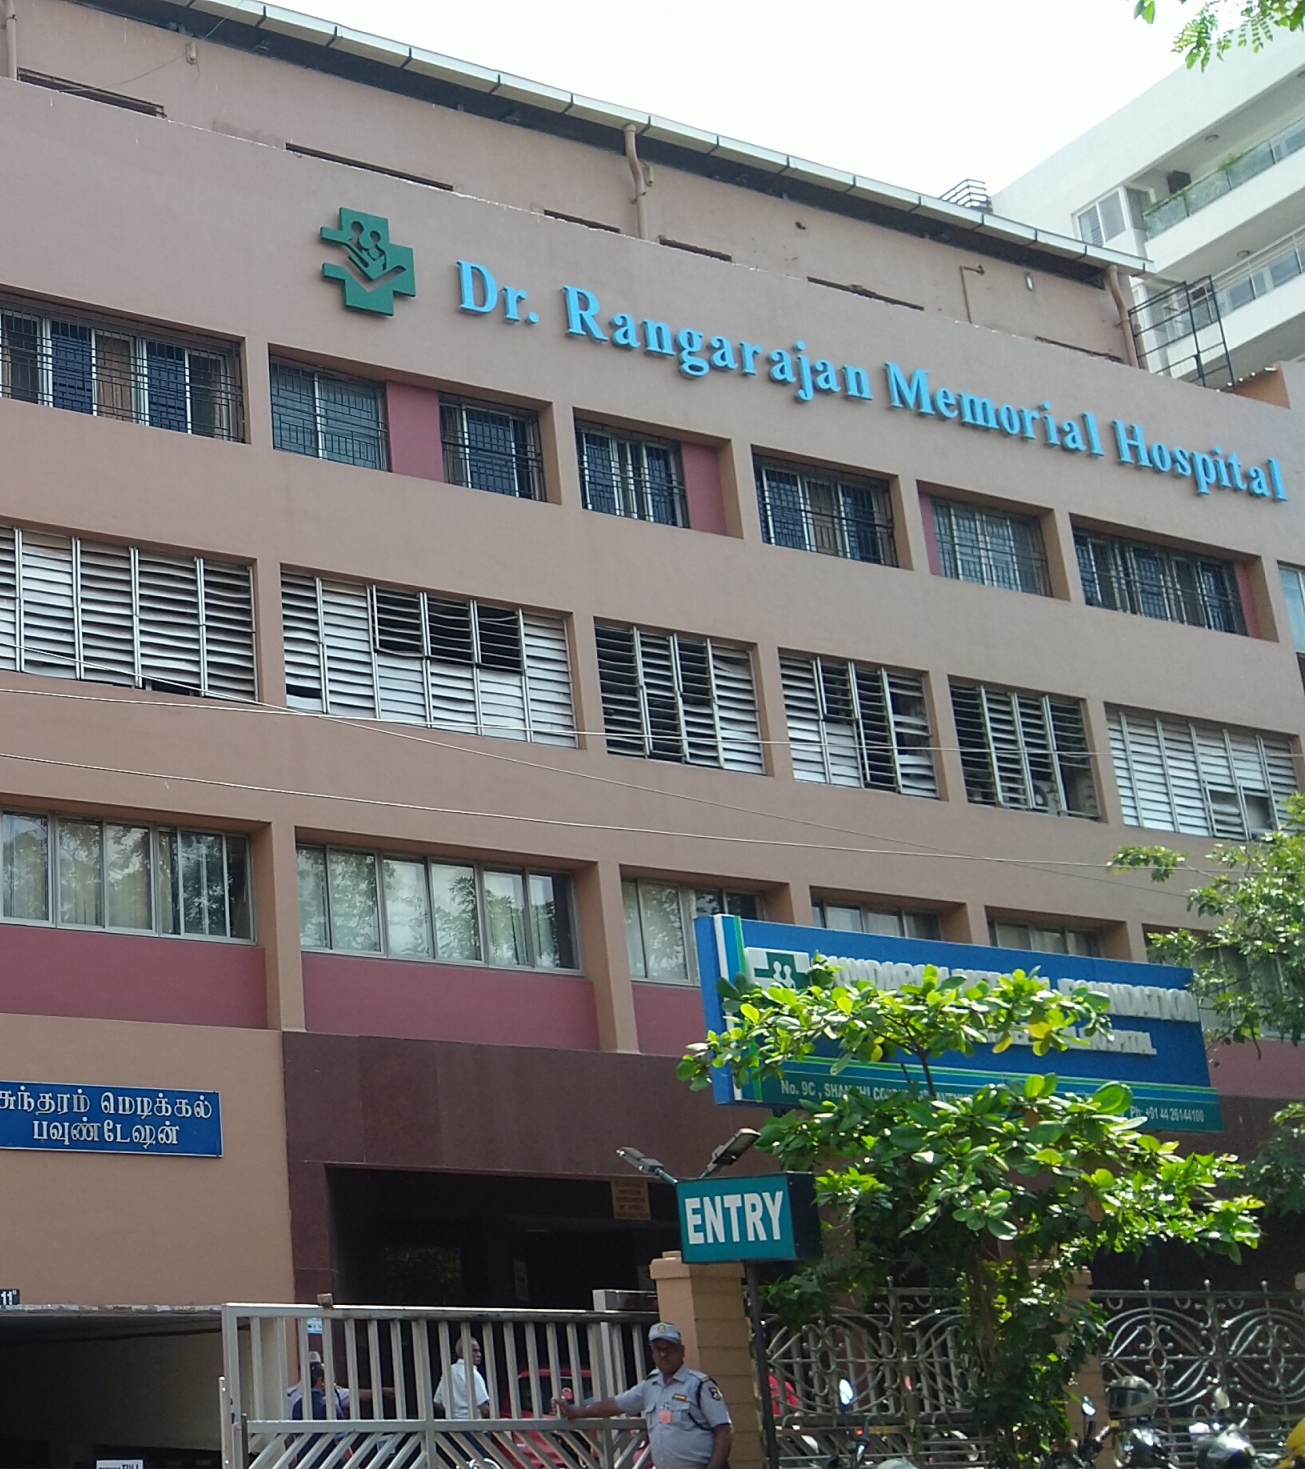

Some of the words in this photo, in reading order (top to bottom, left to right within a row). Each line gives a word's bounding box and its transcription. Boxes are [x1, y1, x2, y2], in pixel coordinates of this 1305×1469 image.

[459, 260, 540, 323] Dr.
[565, 285, 873, 401] Rangarajan
[887, 362, 1104, 456] Memorial
[1115, 420, 1288, 500] Hospital
[780, 1080, 799, 1095] No.
[101, 1092, 212, 1120] மெடிக்கல்
[32, 1116, 180, 1149] பவுண்டேஷன்
[684, 1191, 783, 1245] ENTRY
